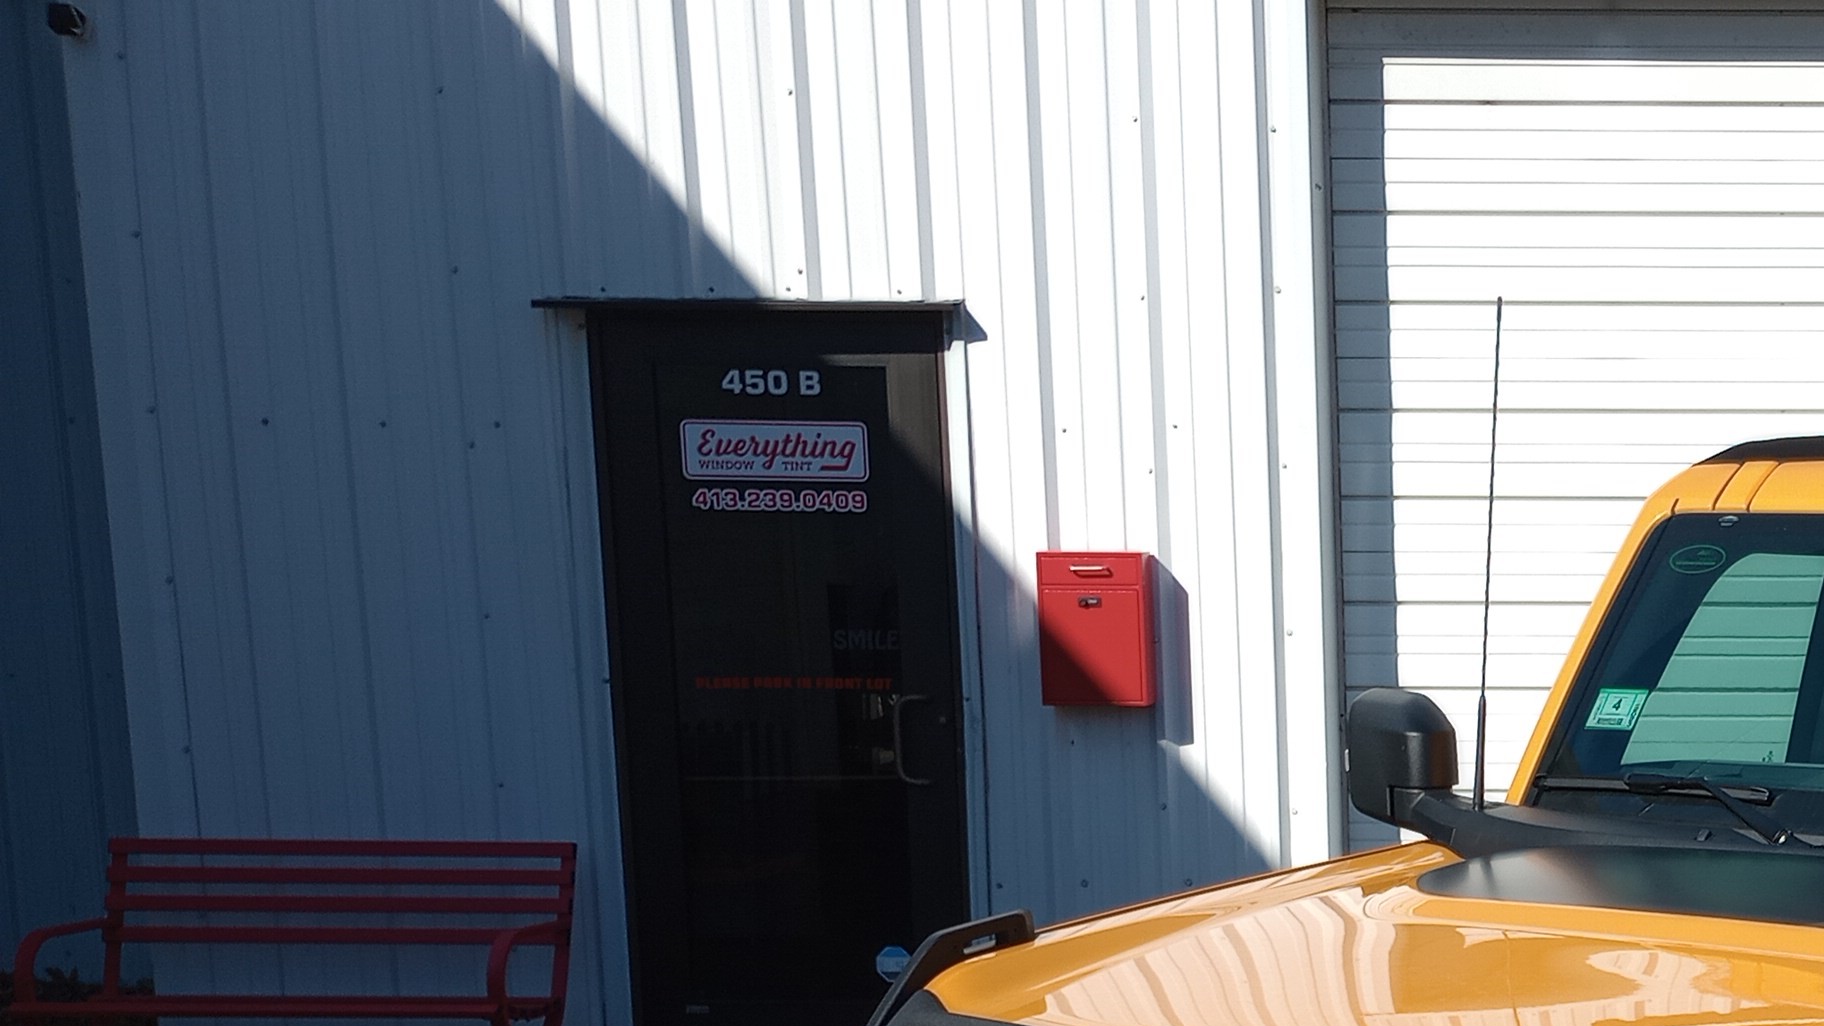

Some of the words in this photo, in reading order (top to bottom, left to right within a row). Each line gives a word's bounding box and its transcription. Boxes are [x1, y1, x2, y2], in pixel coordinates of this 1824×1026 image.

[721, 369, 788, 395] 450
[798, 370, 822, 395] B
[696, 428, 857, 472] Everything
[698, 459, 755, 471] WINDOW
[781, 460, 813, 472] TINT
[692, 488, 867, 513] 413.239.0409
[833, 629, 899, 650] SMILE
